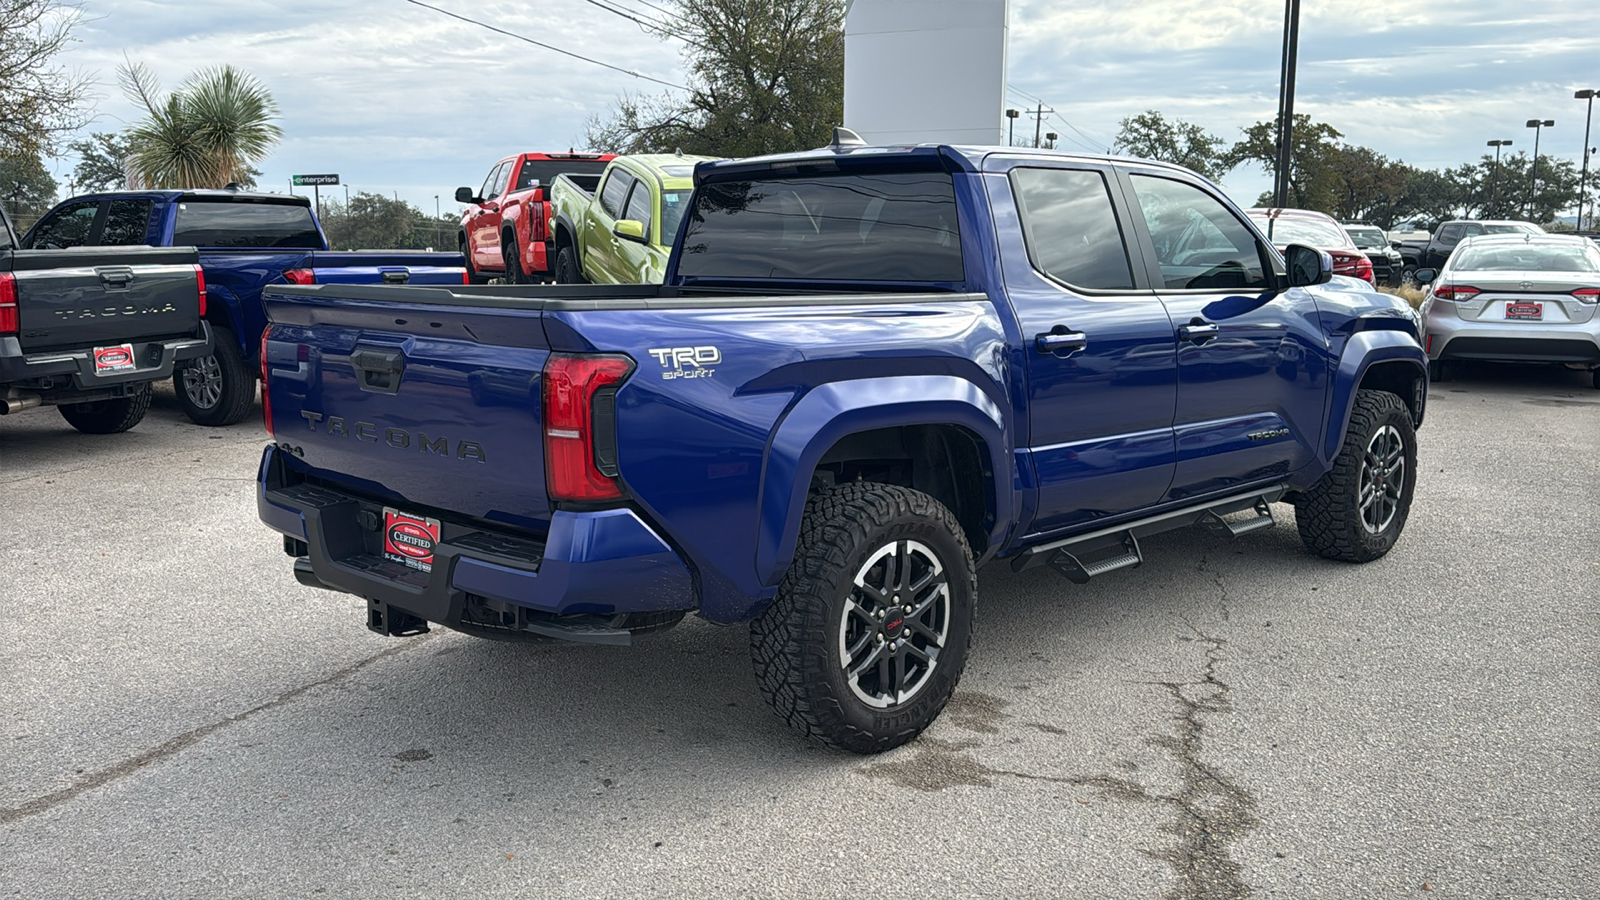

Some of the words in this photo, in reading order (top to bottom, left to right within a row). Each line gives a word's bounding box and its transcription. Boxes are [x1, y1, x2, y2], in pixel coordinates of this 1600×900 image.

[295, 176, 337, 184] enterprise
[55, 303, 176, 320] TACOMA
[648, 346, 721, 370] TRD
[662, 369, 715, 380] SPORT
[300, 409, 486, 465] TACOMA
[1246, 428, 1290, 441] TACOMA
[393, 531, 431, 549] CERTIFIED
